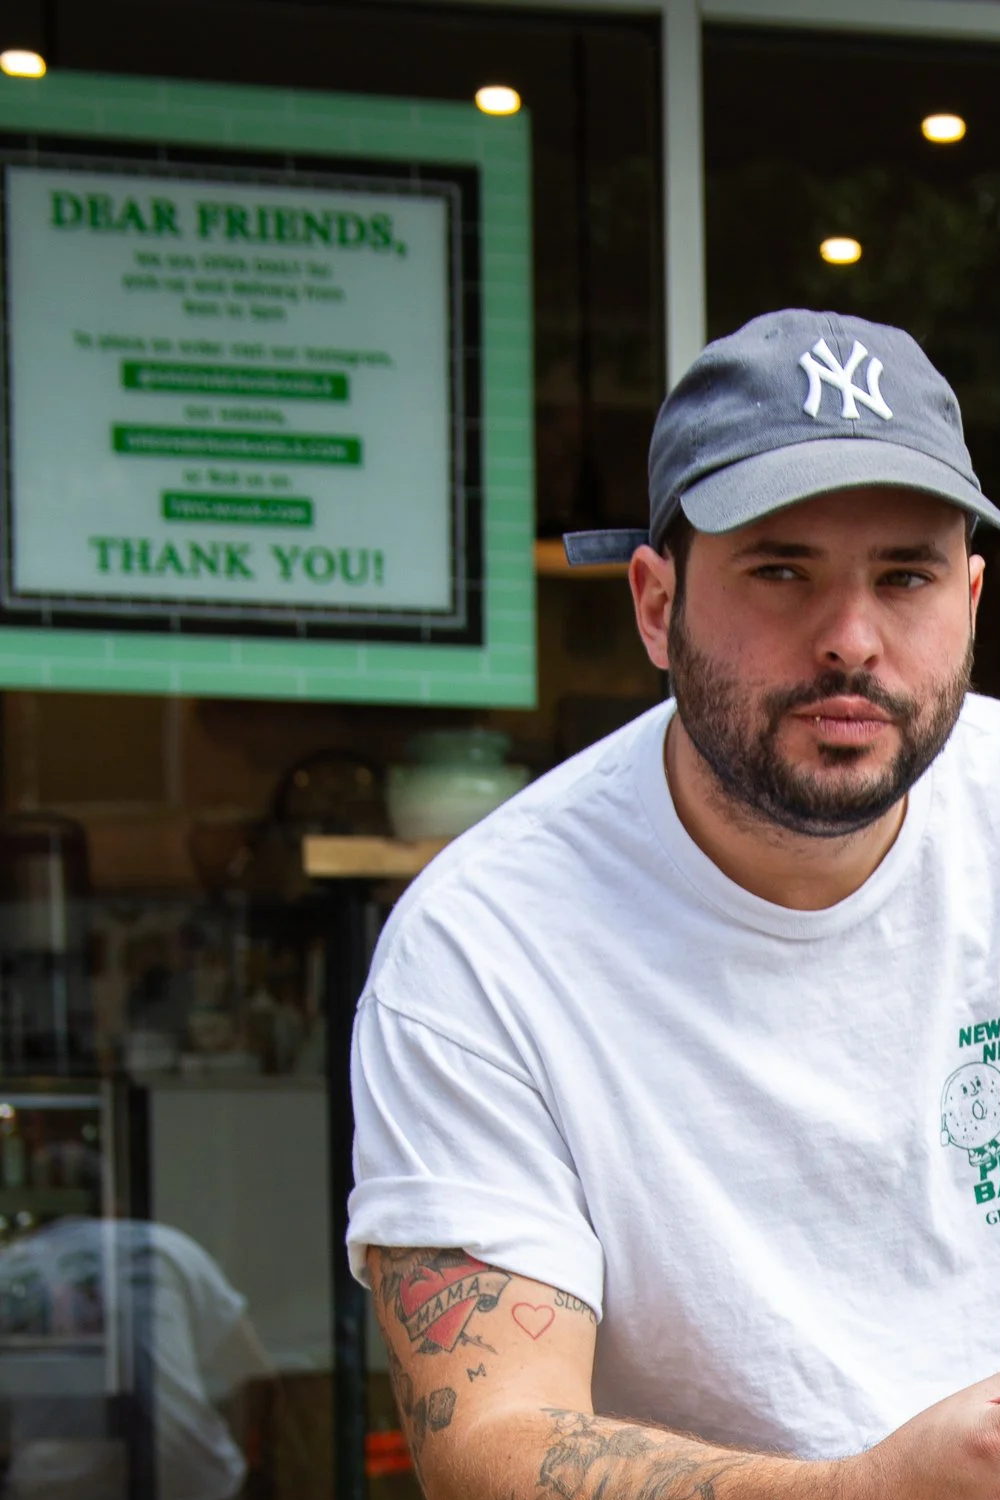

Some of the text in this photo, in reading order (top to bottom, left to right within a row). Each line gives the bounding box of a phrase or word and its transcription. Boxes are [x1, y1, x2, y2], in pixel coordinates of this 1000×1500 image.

[50, 189, 407, 257] DEAR FRIENDS,
[800, 338, 893, 420] NY
[89, 536, 387, 586] THANK YOU!
[415, 1276, 480, 1332] MAMA
